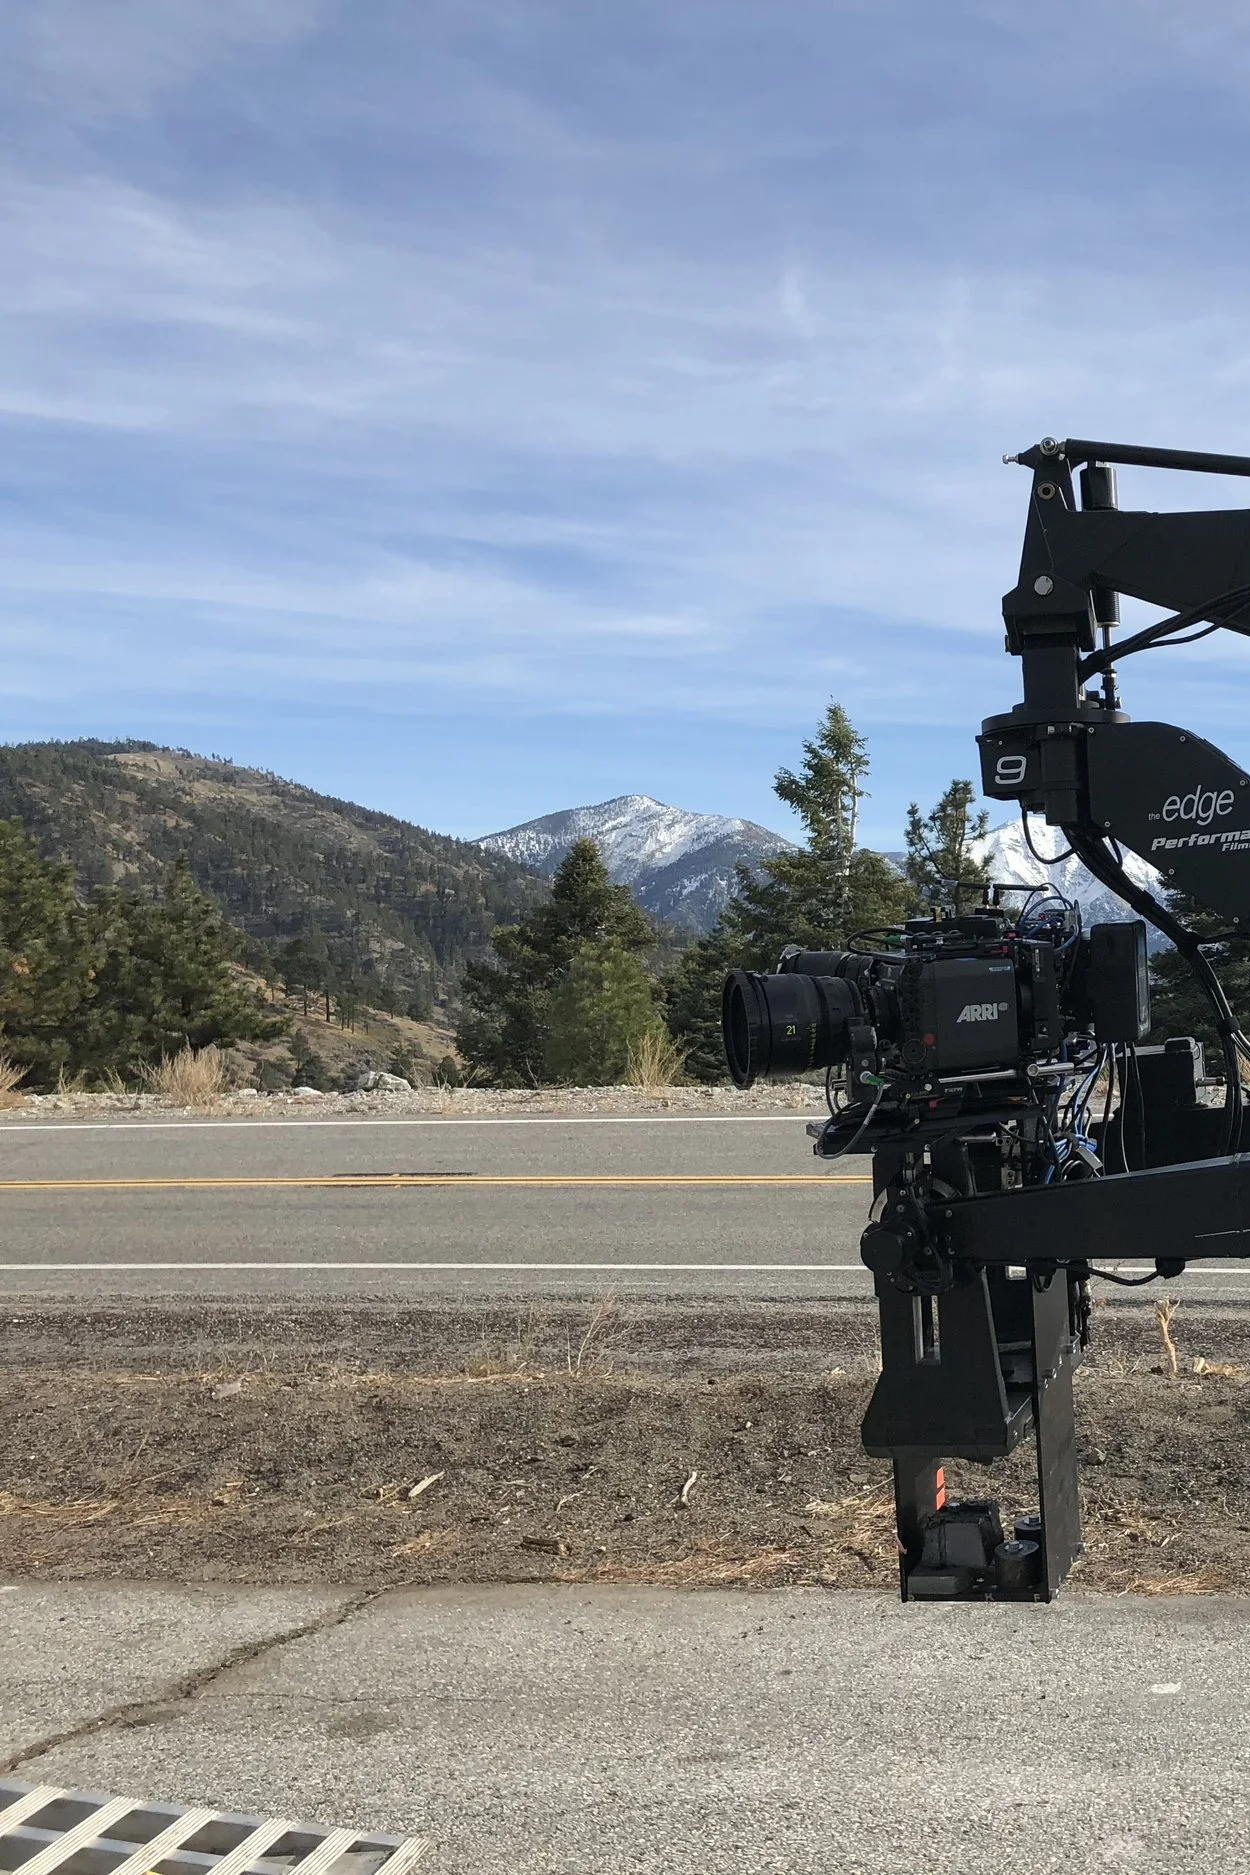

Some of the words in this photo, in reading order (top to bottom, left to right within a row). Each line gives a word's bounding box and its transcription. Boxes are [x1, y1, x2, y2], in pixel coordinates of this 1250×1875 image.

[995, 755, 1027, 785] 9
[1148, 812, 1161, 821] the
[1163, 785, 1234, 825] edge
[956, 1002, 999, 1024] ARRI
[786, 1024, 796, 1035] 21
